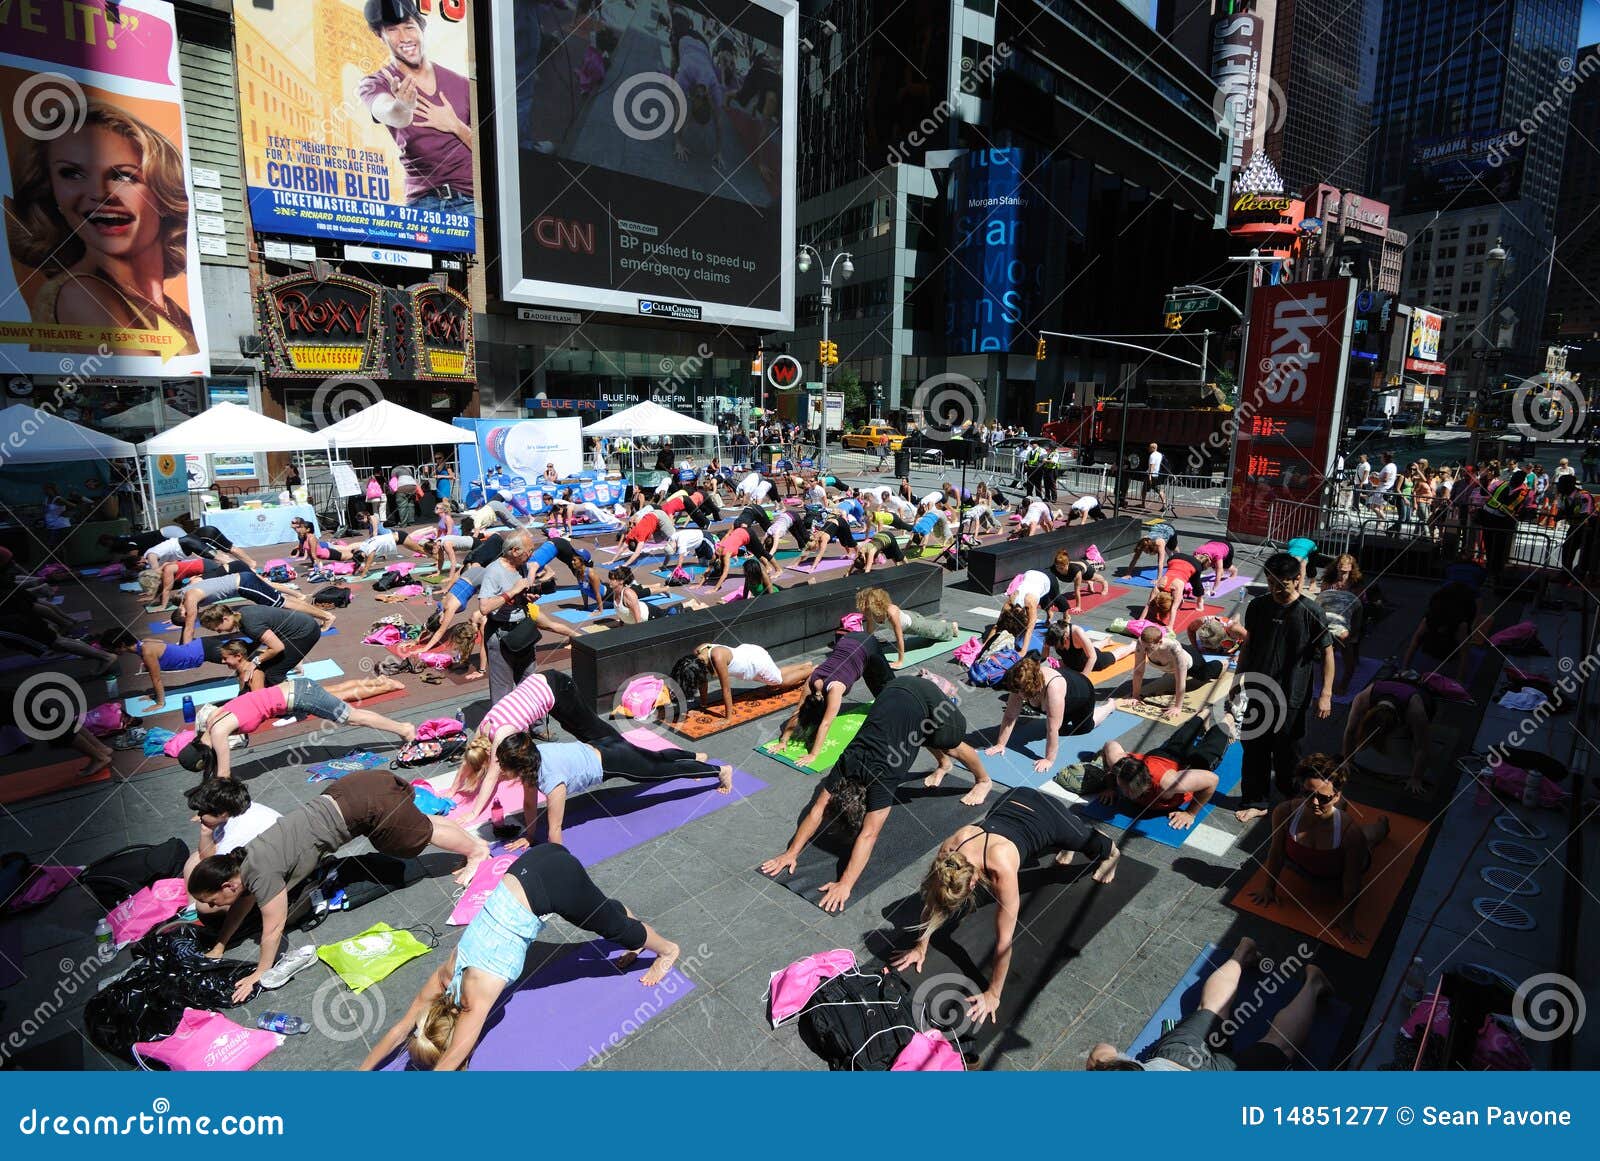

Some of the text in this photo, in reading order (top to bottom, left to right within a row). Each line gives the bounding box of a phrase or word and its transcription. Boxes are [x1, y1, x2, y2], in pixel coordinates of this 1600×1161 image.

[1248, 51, 1259, 109] Chocolate
[268, 135, 291, 149] TEXT
[346, 148, 357, 160] TO
[360, 150, 385, 163] 21534
[266, 148, 389, 176] FOR A VIDEO MESSAGE FROM
[267, 161, 390, 201] CORBIN BLEU
[273, 190, 470, 228] TICKETMASTER.COM 877.250.2929
[969, 196, 1029, 208] Morgan Stanley
[300, 210, 333, 221] RICHARD
[336, 215, 370, 225] RODGERS
[406, 223, 419, 231] 226
[446, 228, 470, 237] STREET
[535, 216, 596, 254] CNN
[384, 251, 408, 264] CBS
[620, 234, 756, 272] BP pushed to speed up
[620, 257, 731, 284] emergency claims
[276, 290, 369, 334] ROXY
[1184, 301, 1197, 310] 47
[37, 328, 84, 340] THEATRE
[101, 331, 113, 341] AT
[138, 333, 173, 344] STREET
[296, 351, 359, 365] DELICATESSEN
[1266, 292, 1329, 405] tkts
[431, 356, 464, 369] DELICATESSEN
[773, 363, 797, 383] W
[540, 399, 596, 409] BLUE FIN
[602, 393, 639, 402] BLUE FIN
[652, 394, 672, 402] BLUE
[697, 395, 715, 403] BLUE
